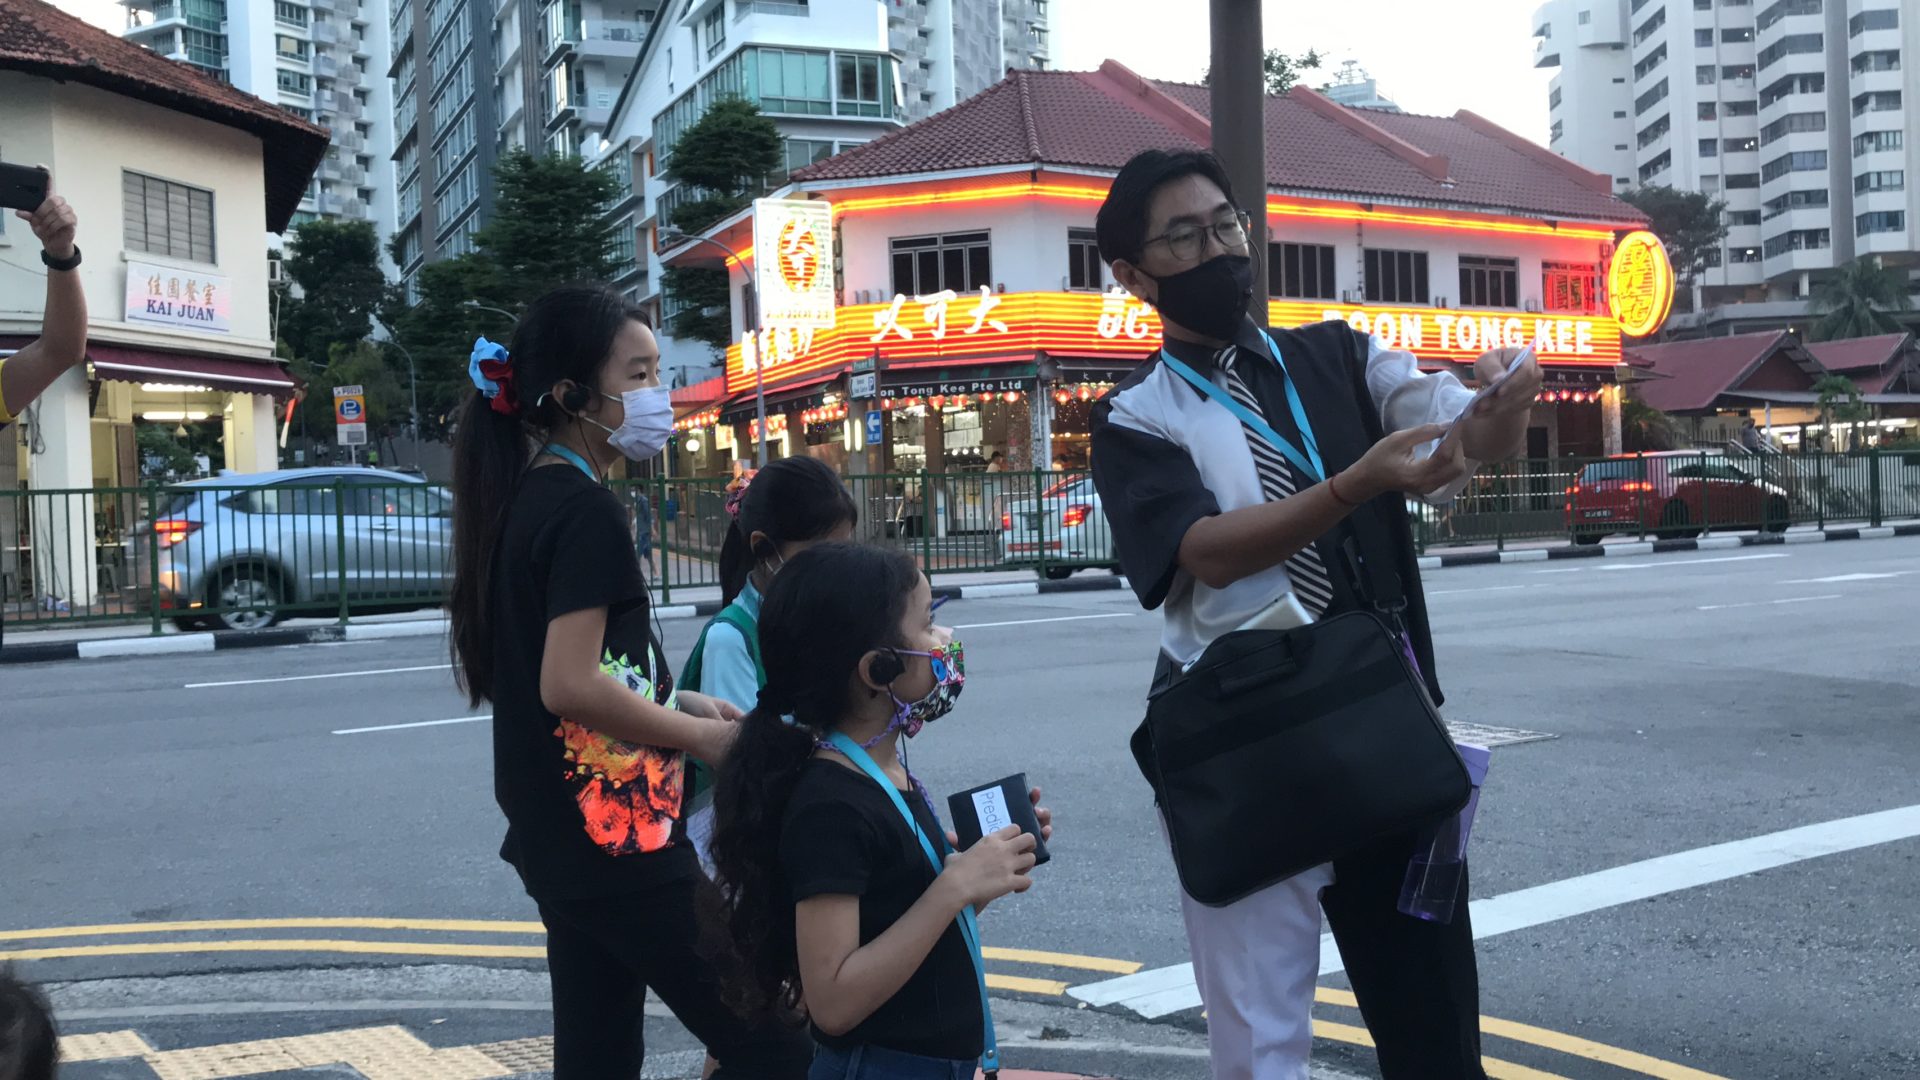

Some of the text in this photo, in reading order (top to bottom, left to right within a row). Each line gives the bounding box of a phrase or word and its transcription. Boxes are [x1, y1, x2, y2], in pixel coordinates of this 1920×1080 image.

[146, 299, 215, 322] KAI JUAN
[1322, 310, 1594, 354] OON TONG KEE
[902, 386, 933, 396] Tong
[940, 384, 966, 393] Kee
[972, 382, 994, 391] Pte
[1000, 380, 1022, 390] Ltd
